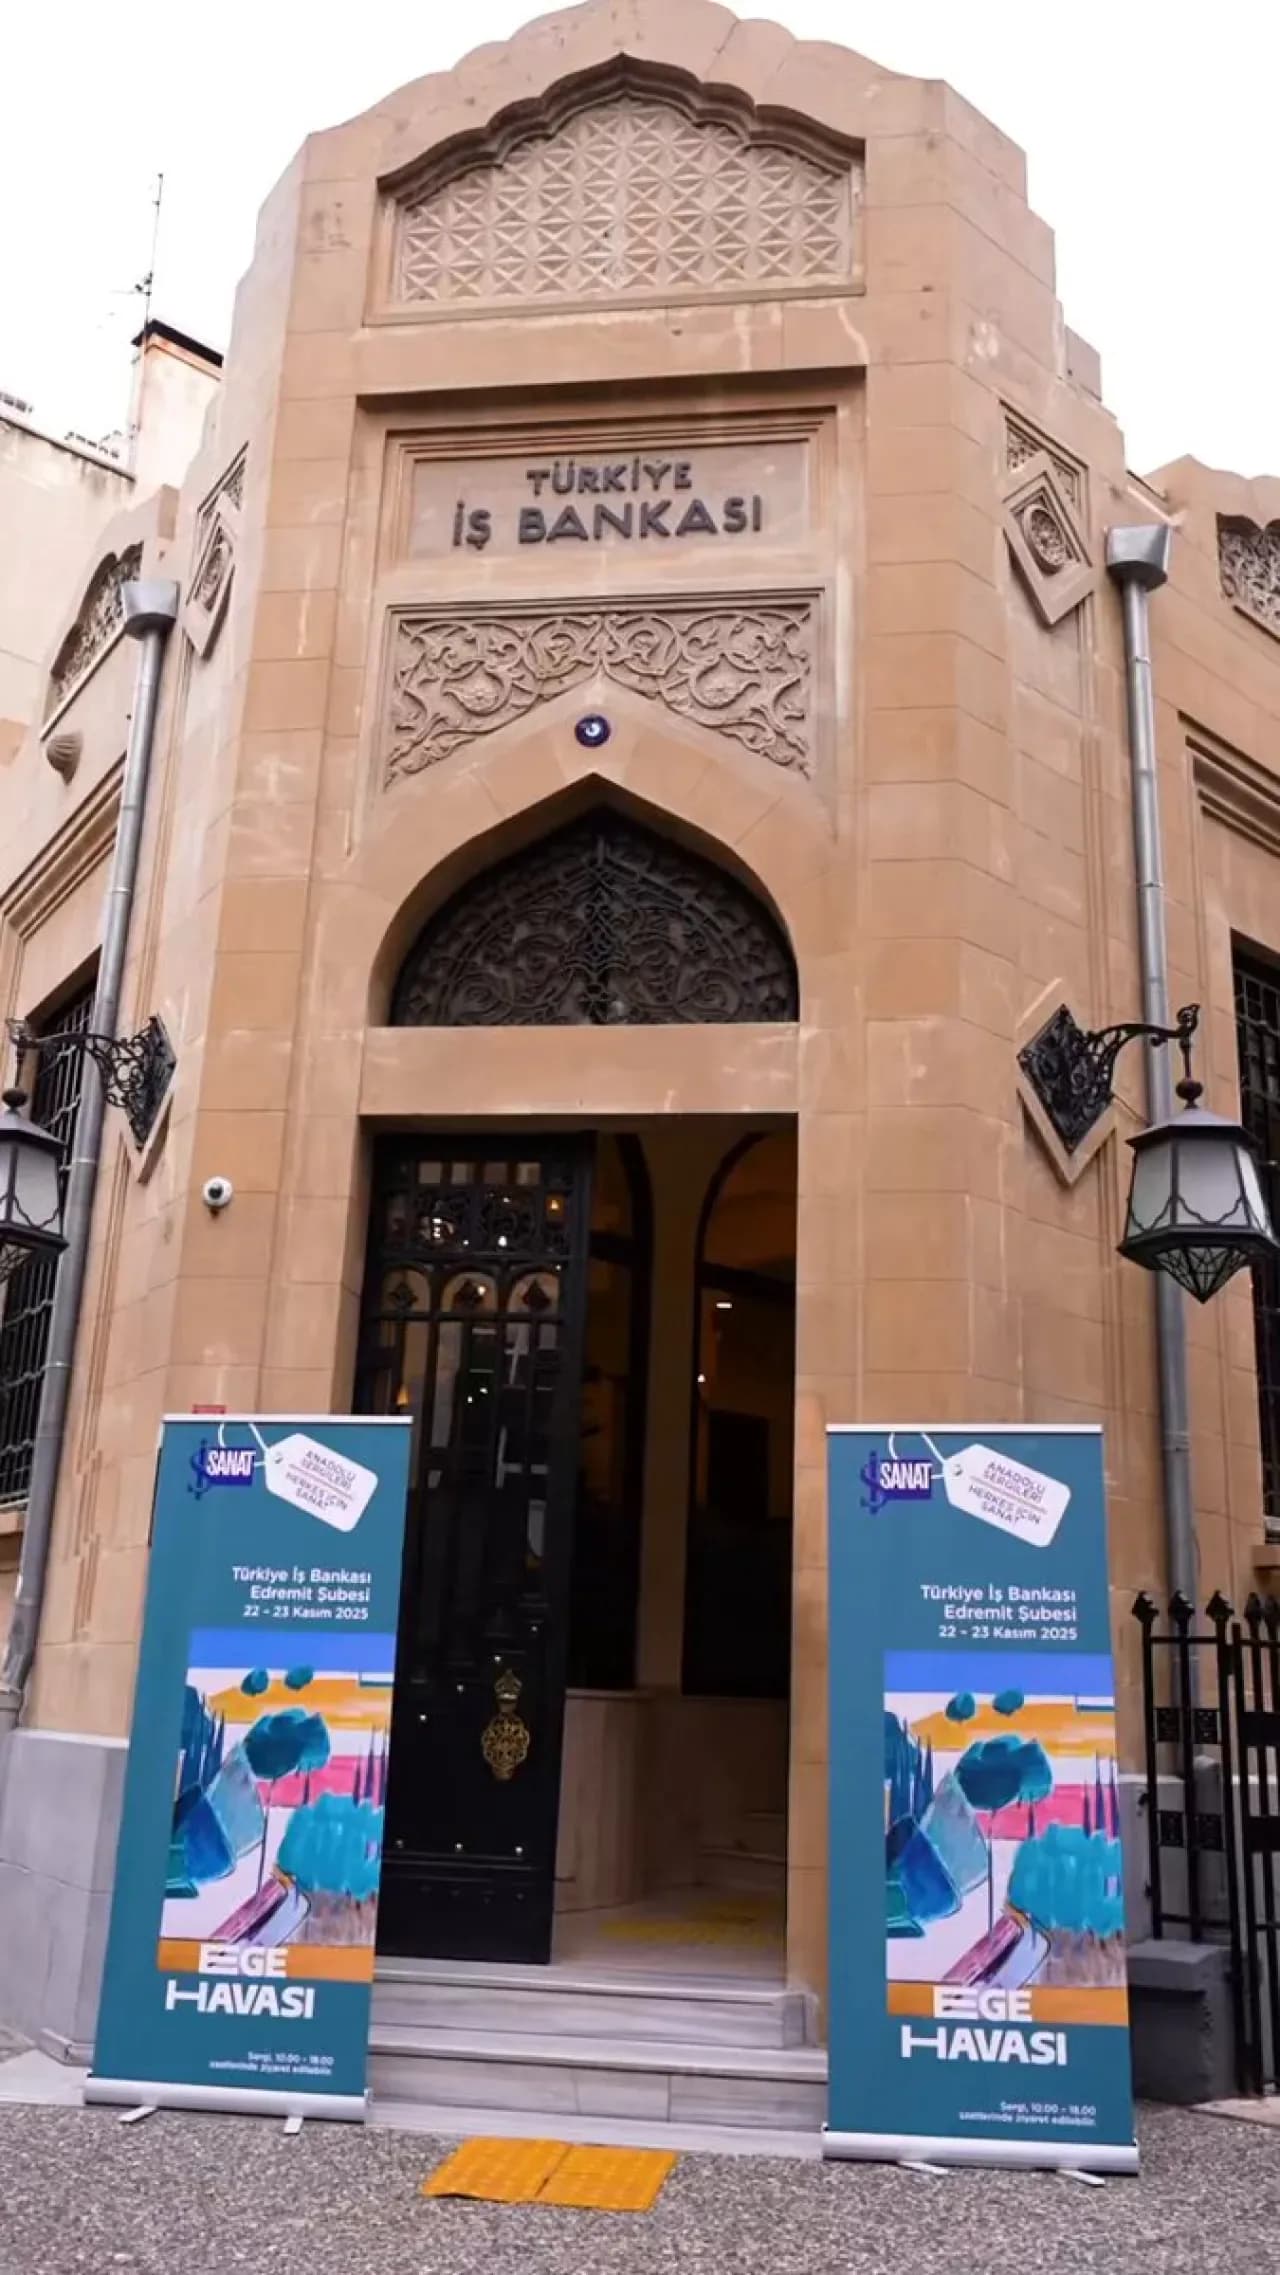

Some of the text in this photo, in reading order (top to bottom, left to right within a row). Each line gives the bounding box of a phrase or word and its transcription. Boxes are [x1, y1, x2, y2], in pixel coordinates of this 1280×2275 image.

[526, 456, 692, 497] TÜRKİYE
[452, 495, 762, 550] İŞ BANKASI
[206, 1450, 256, 1476] SANAT
[881, 1463, 933, 1489] SANAT
[987, 1462, 1046, 1495] ANADOLU
[232, 1565, 371, 1583] Türkiye İş Bankası
[250, 1585, 370, 1602] Edremit Şubesi
[920, 1584, 1076, 1602] Türkiye İş Bankası
[243, 1605, 259, 1617] 22
[272, 1605, 289, 1617] 23
[293, 1606, 333, 1618] Kasım
[335, 1606, 368, 1620] 2025
[944, 1605, 1077, 1622] Edremit Şubesi
[938, 1625, 956, 1637] 22
[972, 1626, 989, 1638] 23
[993, 1627, 1036, 1638] Kasım
[1040, 1627, 1077, 1640] 2025
[198, 1943, 288, 1977] EGE
[165, 1979, 315, 2019] HAVASI
[933, 1985, 1032, 2022] EGE
[901, 2024, 1067, 2066] HAVASI
